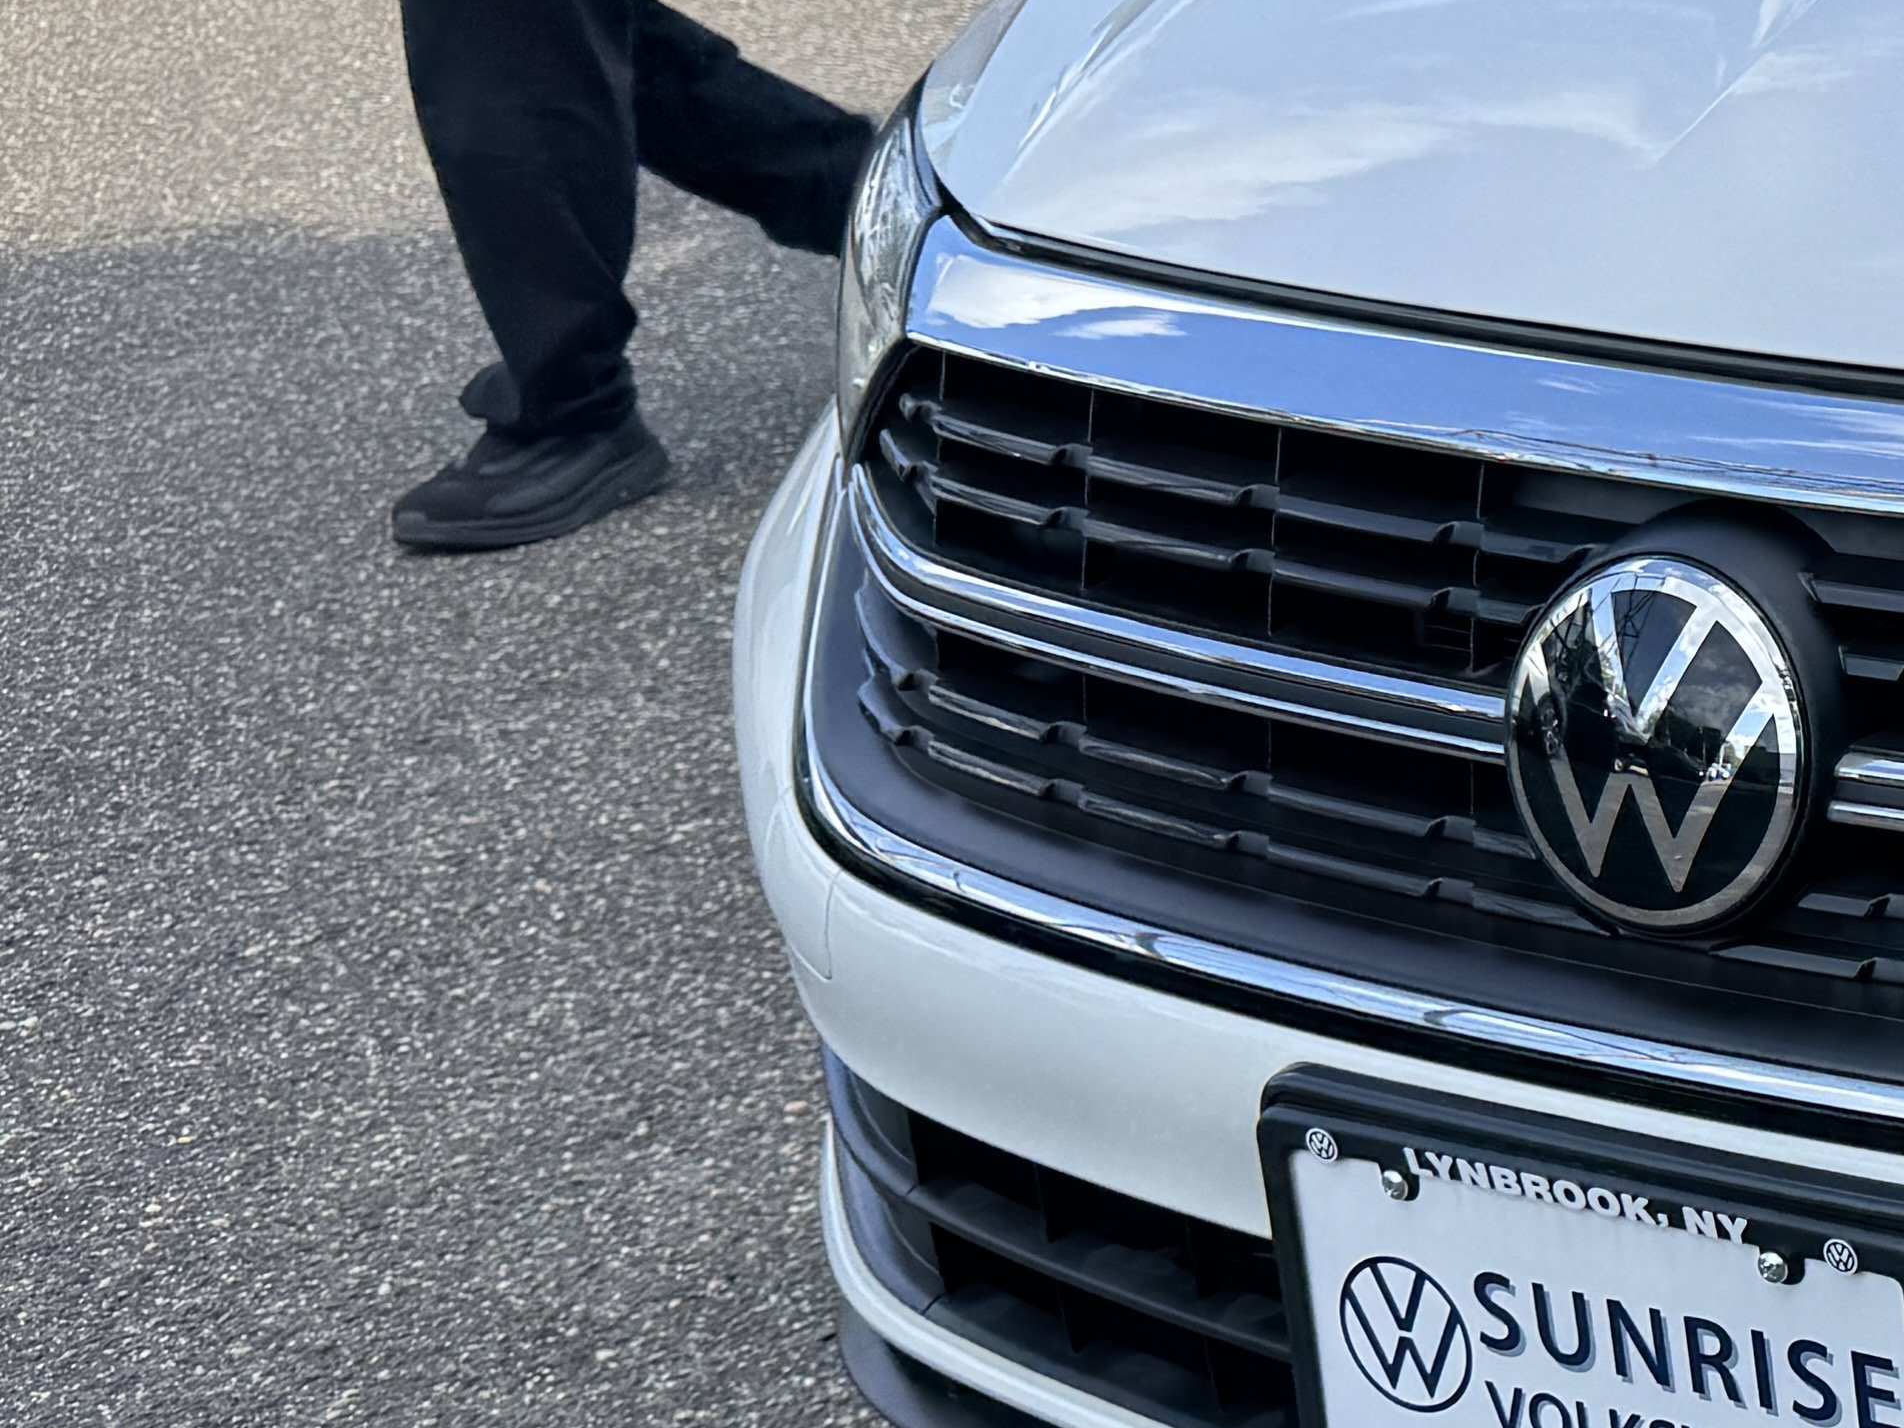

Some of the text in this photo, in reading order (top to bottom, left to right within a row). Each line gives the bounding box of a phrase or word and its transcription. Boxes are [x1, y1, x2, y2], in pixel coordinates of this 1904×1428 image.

[1508, 560, 1801, 923] VW
[1403, 1147, 1748, 1245] LYNBROOK, NY
[1339, 1256, 1473, 1413] VW
